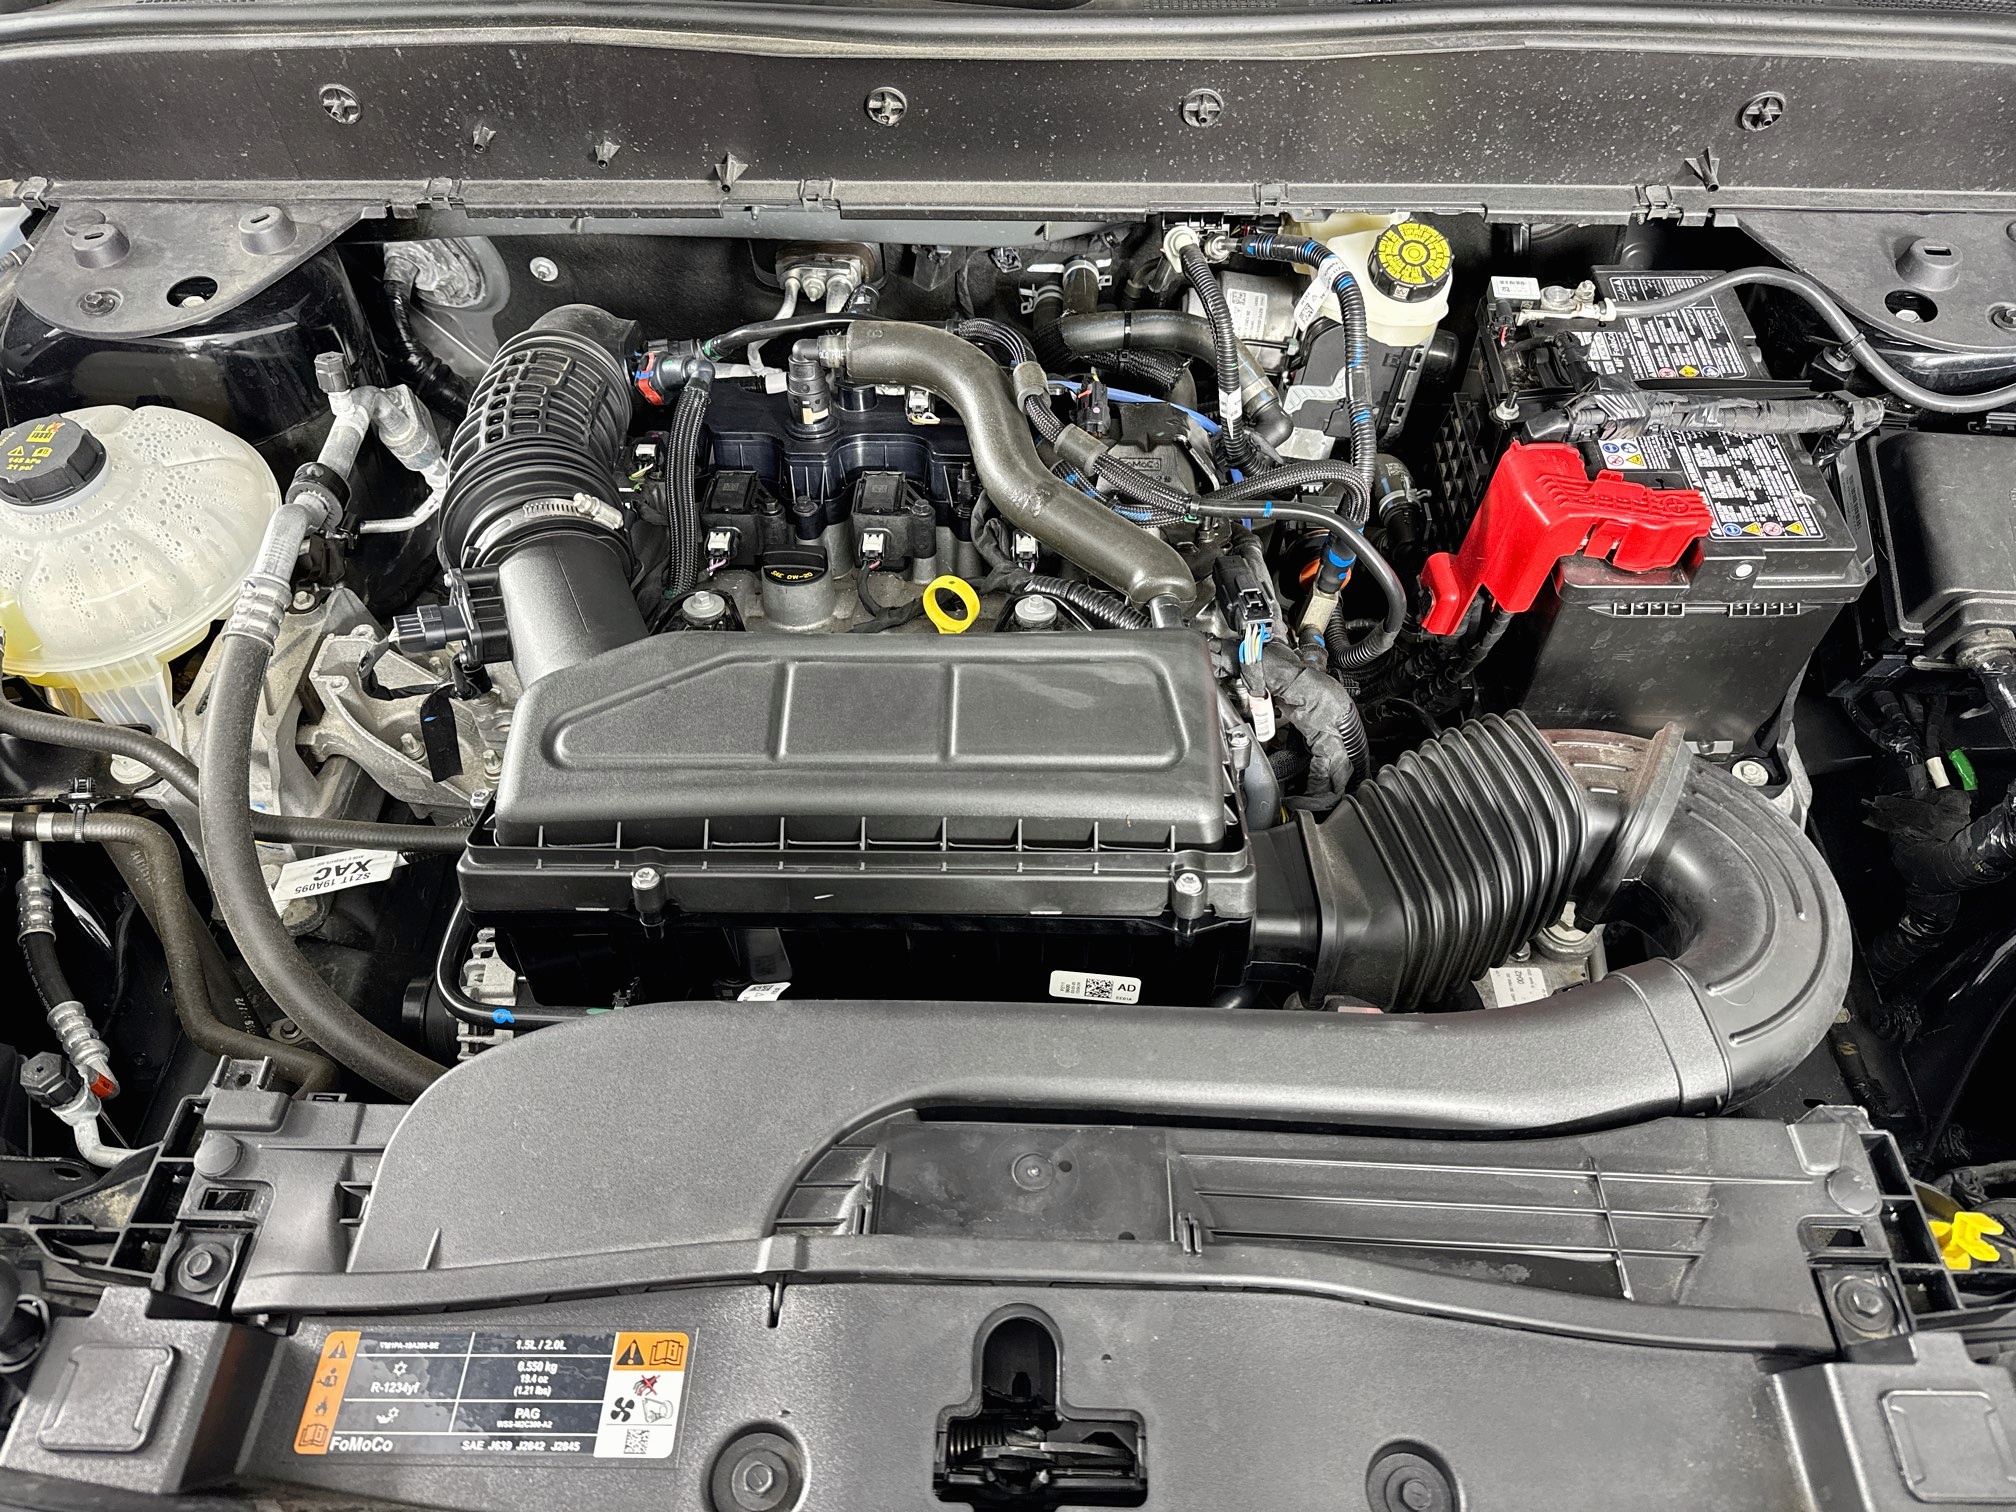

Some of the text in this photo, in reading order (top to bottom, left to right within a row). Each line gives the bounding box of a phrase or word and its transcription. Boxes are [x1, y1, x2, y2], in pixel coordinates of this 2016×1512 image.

[770, 570, 814, 580] SAE 0W-20
[313, 859, 374, 882] XAC
[294, 878, 336, 895] 19A095
[1117, 983, 1137, 993] AD
[516, 1339, 537, 1350] 1.5L
[544, 1339, 568, 1350] 2.0L
[517, 1360, 559, 1375] 0.550 kg
[520, 1374, 549, 1384] 19.4 oz
[370, 1381, 421, 1396] R-1234yf
[513, 1386, 534, 1397] (1.21
[514, 1407, 541, 1420] PAG
[329, 1436, 394, 1452] FoMoCo
[461, 1440, 581, 1452] SAE J639 J2842 J2845
